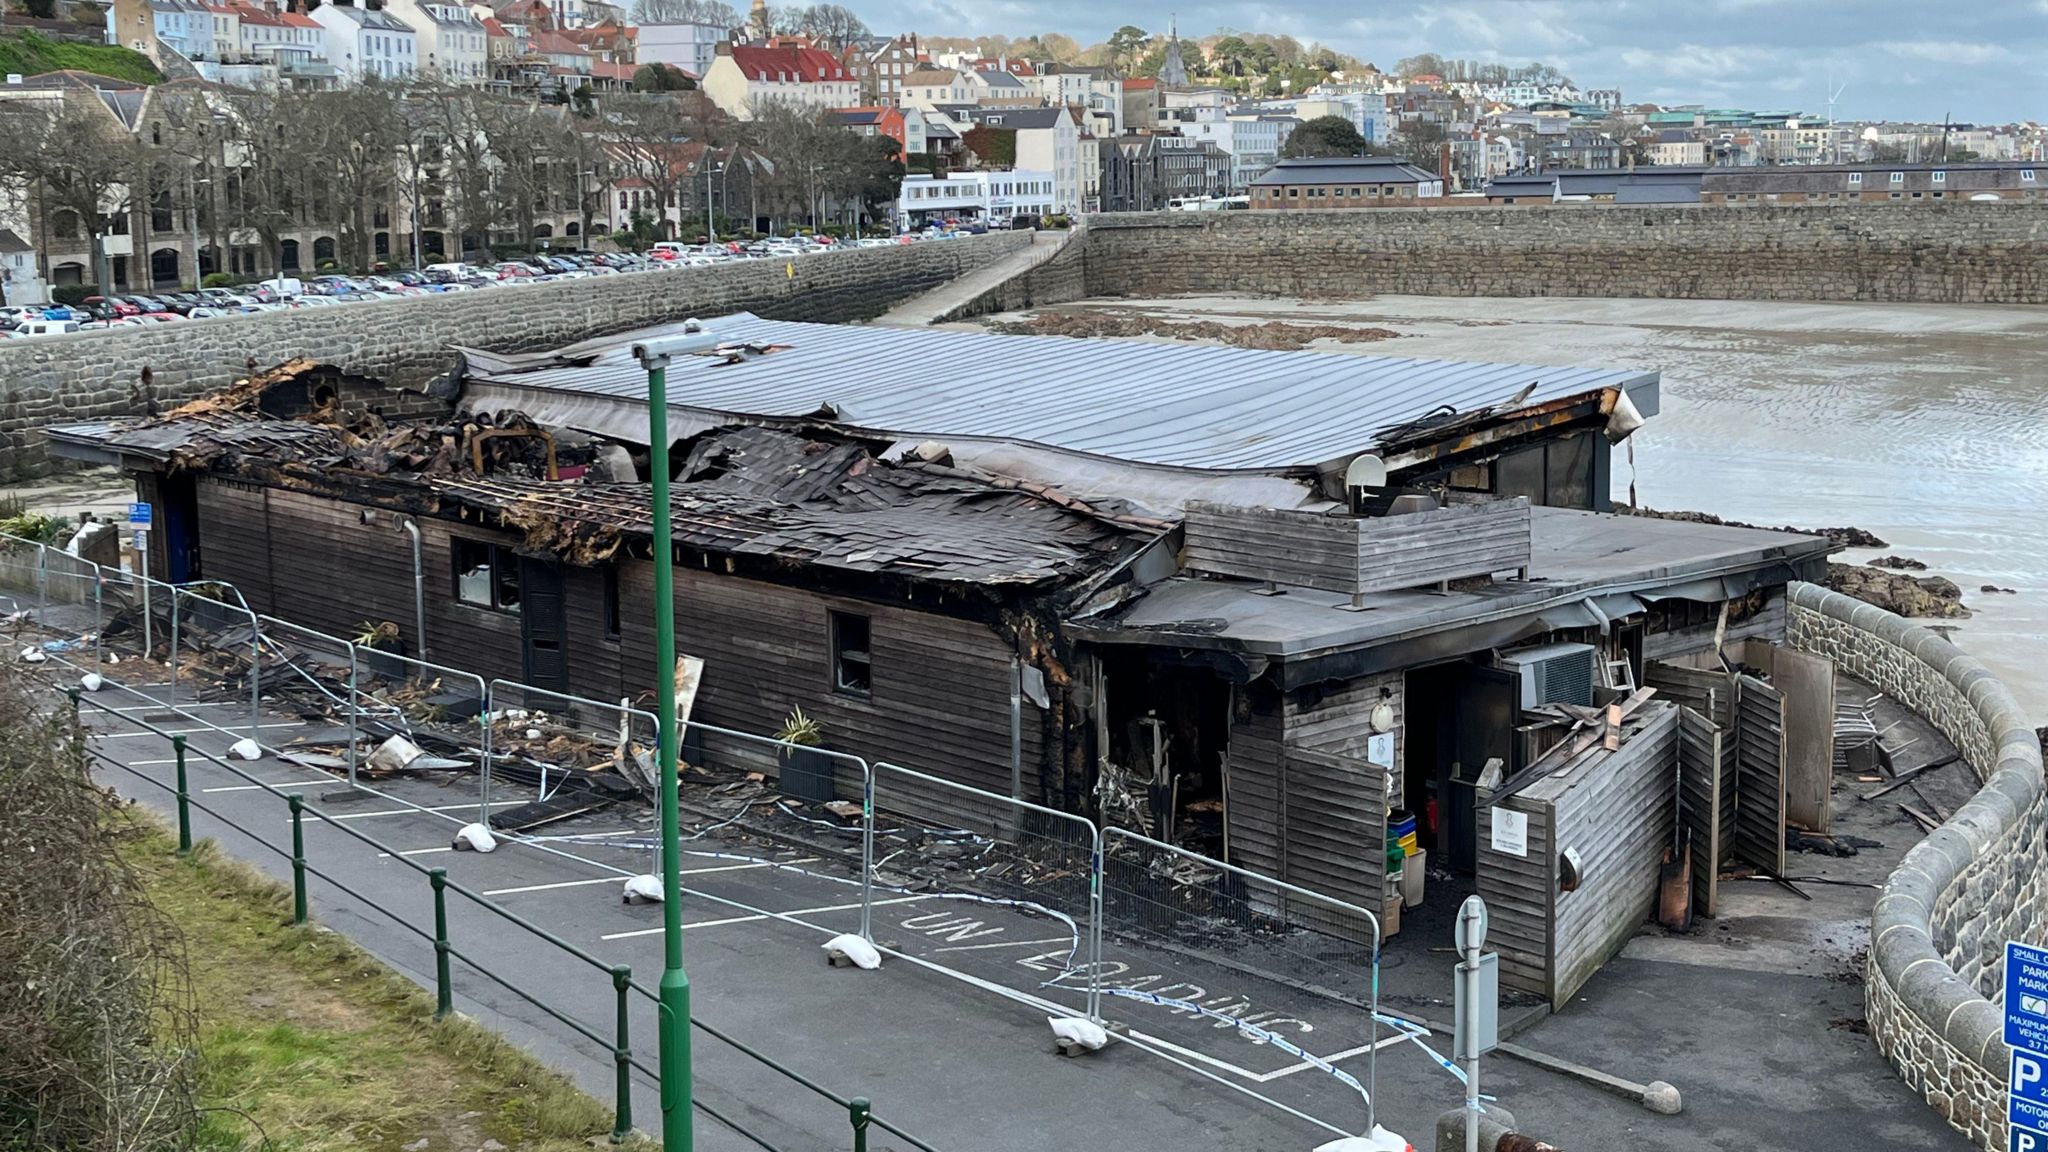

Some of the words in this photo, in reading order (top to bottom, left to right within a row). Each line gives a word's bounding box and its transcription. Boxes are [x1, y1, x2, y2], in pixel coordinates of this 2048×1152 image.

[900, 911, 1005, 942] UN
[2013, 948, 2040, 962] SMALL
[2022, 965, 2048, 979] PARK
[2018, 976, 2048, 992] MARK
[2008, 1014, 2048, 1032] MAXIMUM
[2028, 1040, 2041, 1050] 3.7
[2014, 1056, 2041, 1092] P
[2040, 1087, 2048, 1098] 2
[2016, 1102, 2048, 1119] MOTOR
[2018, 1132, 2035, 1152] P
